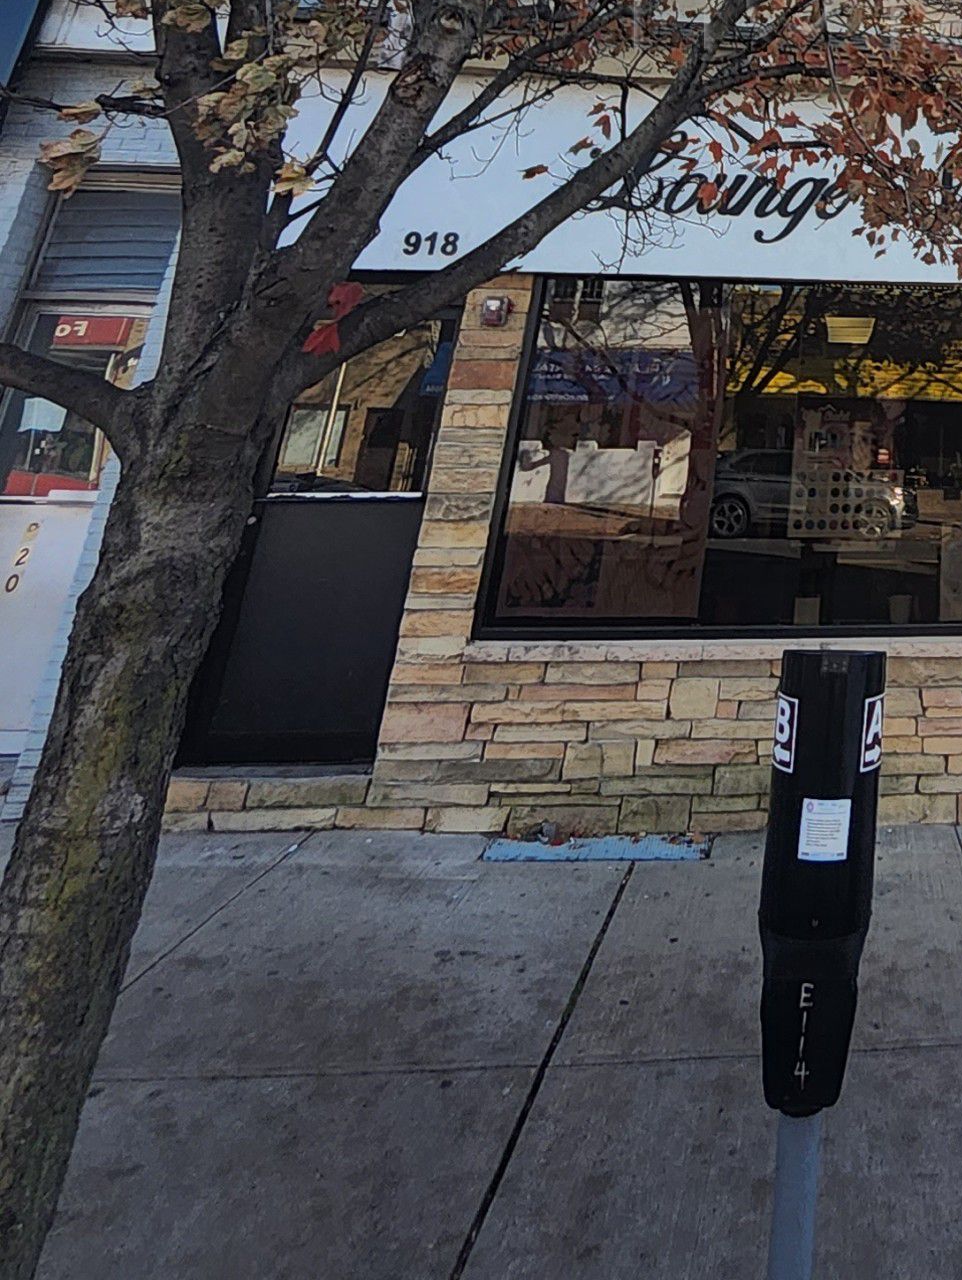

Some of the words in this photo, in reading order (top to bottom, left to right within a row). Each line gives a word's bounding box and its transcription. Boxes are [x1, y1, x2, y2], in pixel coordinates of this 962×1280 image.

[402, 231, 460, 256] 918
[775, 699, 791, 743] B
[866, 700, 882, 745] A
